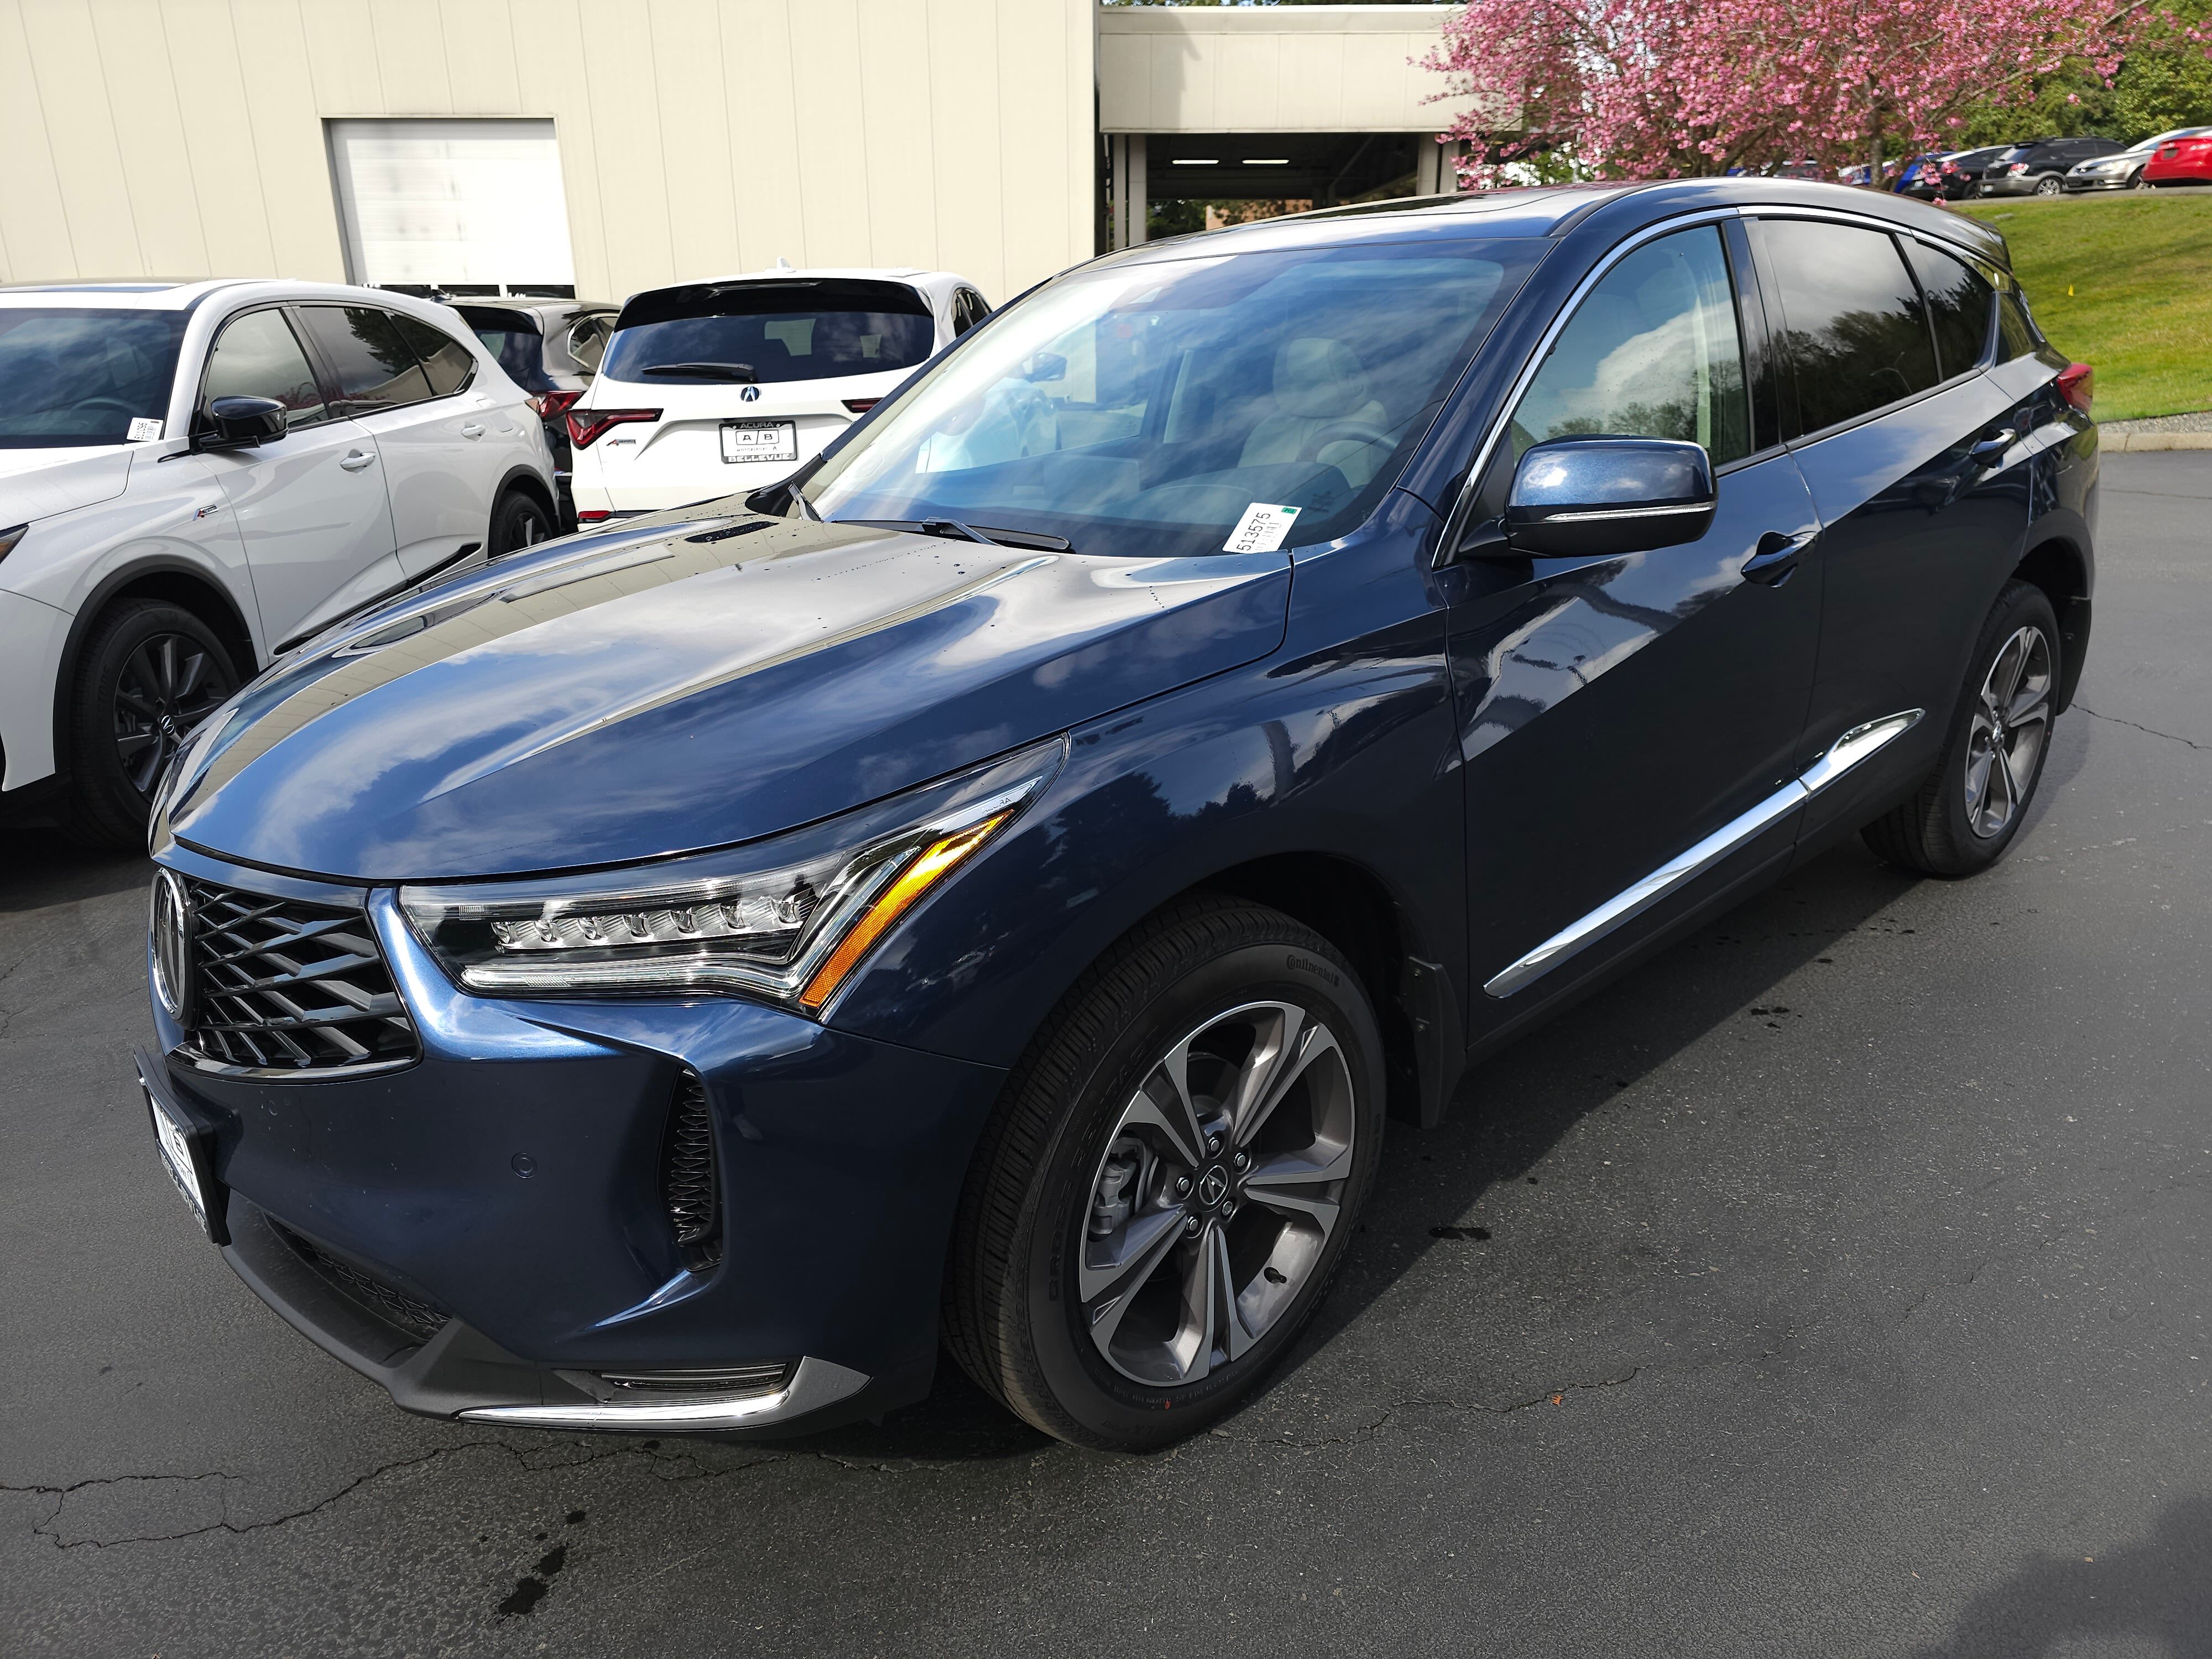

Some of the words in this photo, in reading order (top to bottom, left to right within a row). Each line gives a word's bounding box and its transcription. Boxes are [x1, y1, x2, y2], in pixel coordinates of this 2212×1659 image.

[728, 453, 791, 462] BELLEVUE
[1236, 512, 1271, 551] 513575
[1286, 954, 1334, 984] Continental
